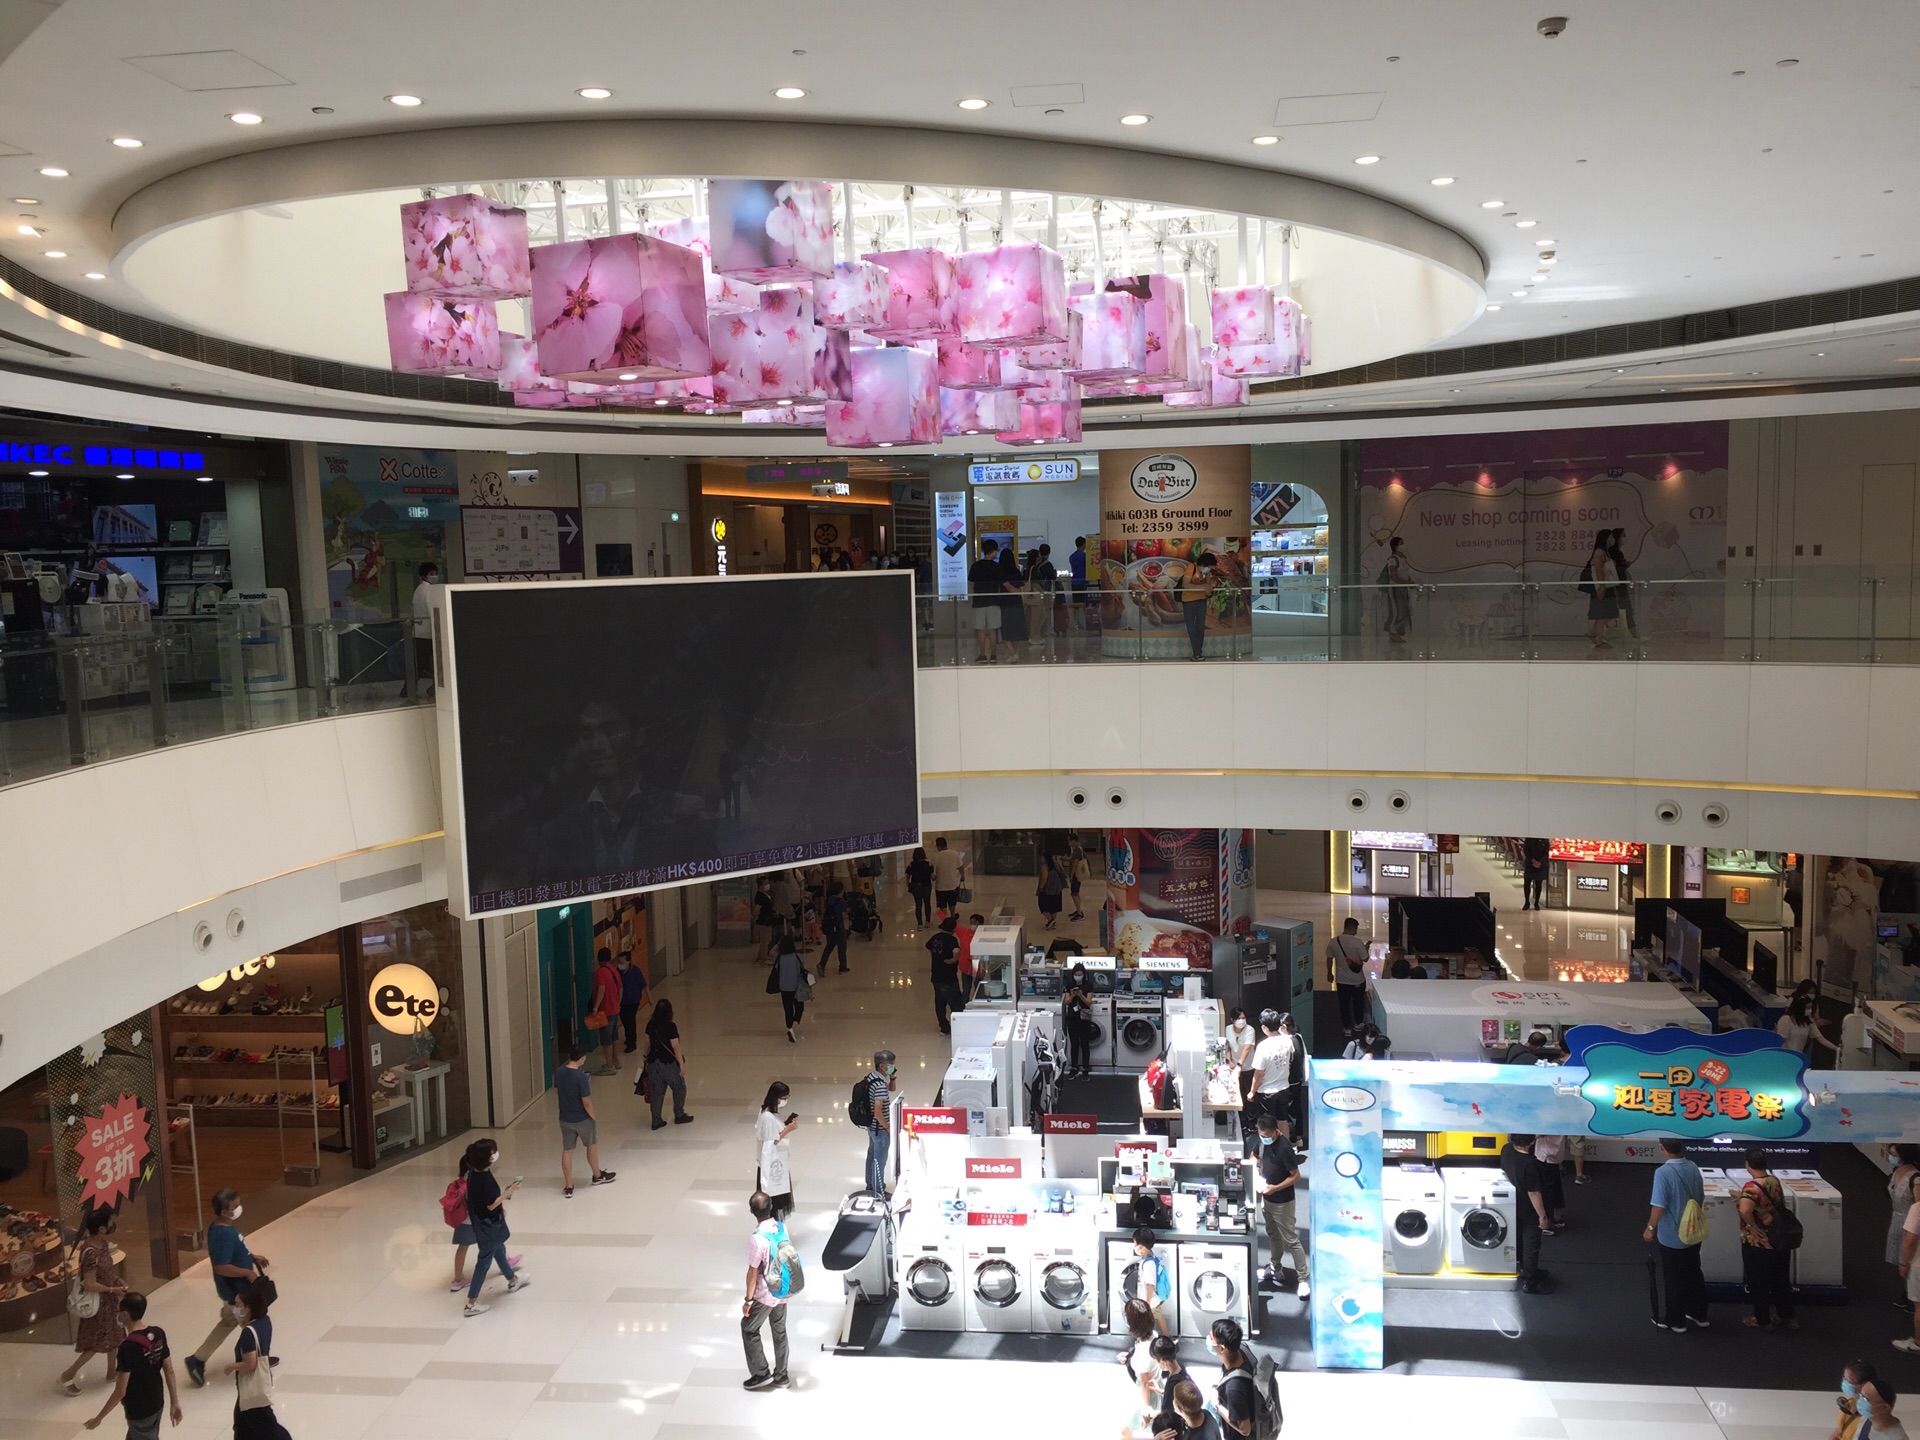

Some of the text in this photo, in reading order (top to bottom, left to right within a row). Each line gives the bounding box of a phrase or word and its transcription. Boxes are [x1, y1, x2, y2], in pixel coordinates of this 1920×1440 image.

[1045, 464, 1073, 474] SUN
[1137, 475, 1191, 488] Das Bier
[1128, 509, 1158, 520] G03B
[1162, 507, 1204, 519] Ground
[1208, 506, 1233, 518] Floor
[1420, 506, 1620, 528] New shop coming soon
[1121, 521, 1209, 534] Tel: 2359 3899
[1536, 531, 1566, 541] 2828
[1456, 539, 1492, 549] Leasing
[1536, 541, 1596, 552] 2828 516
[239, 592, 268, 600] Panasonic
[1165, 879, 1209, 893] 五大特色
[1146, 961, 1181, 969] SIEMENS
[1706, 1061, 1726, 1075] 9-22
[1700, 1068, 1723, 1082] JUNE
[1612, 1084, 1784, 1120] 迎夏家電祭
[913, 1114, 956, 1125] Miele
[1050, 1120, 1091, 1129] Miele
[91, 1111, 135, 1148] SALE
[104, 1138, 126, 1153] UP TO
[1382, 1138, 1416, 1150] ANUSSI
[94, 1142, 136, 1190] 3折
[971, 1163, 1016, 1174] Miele
